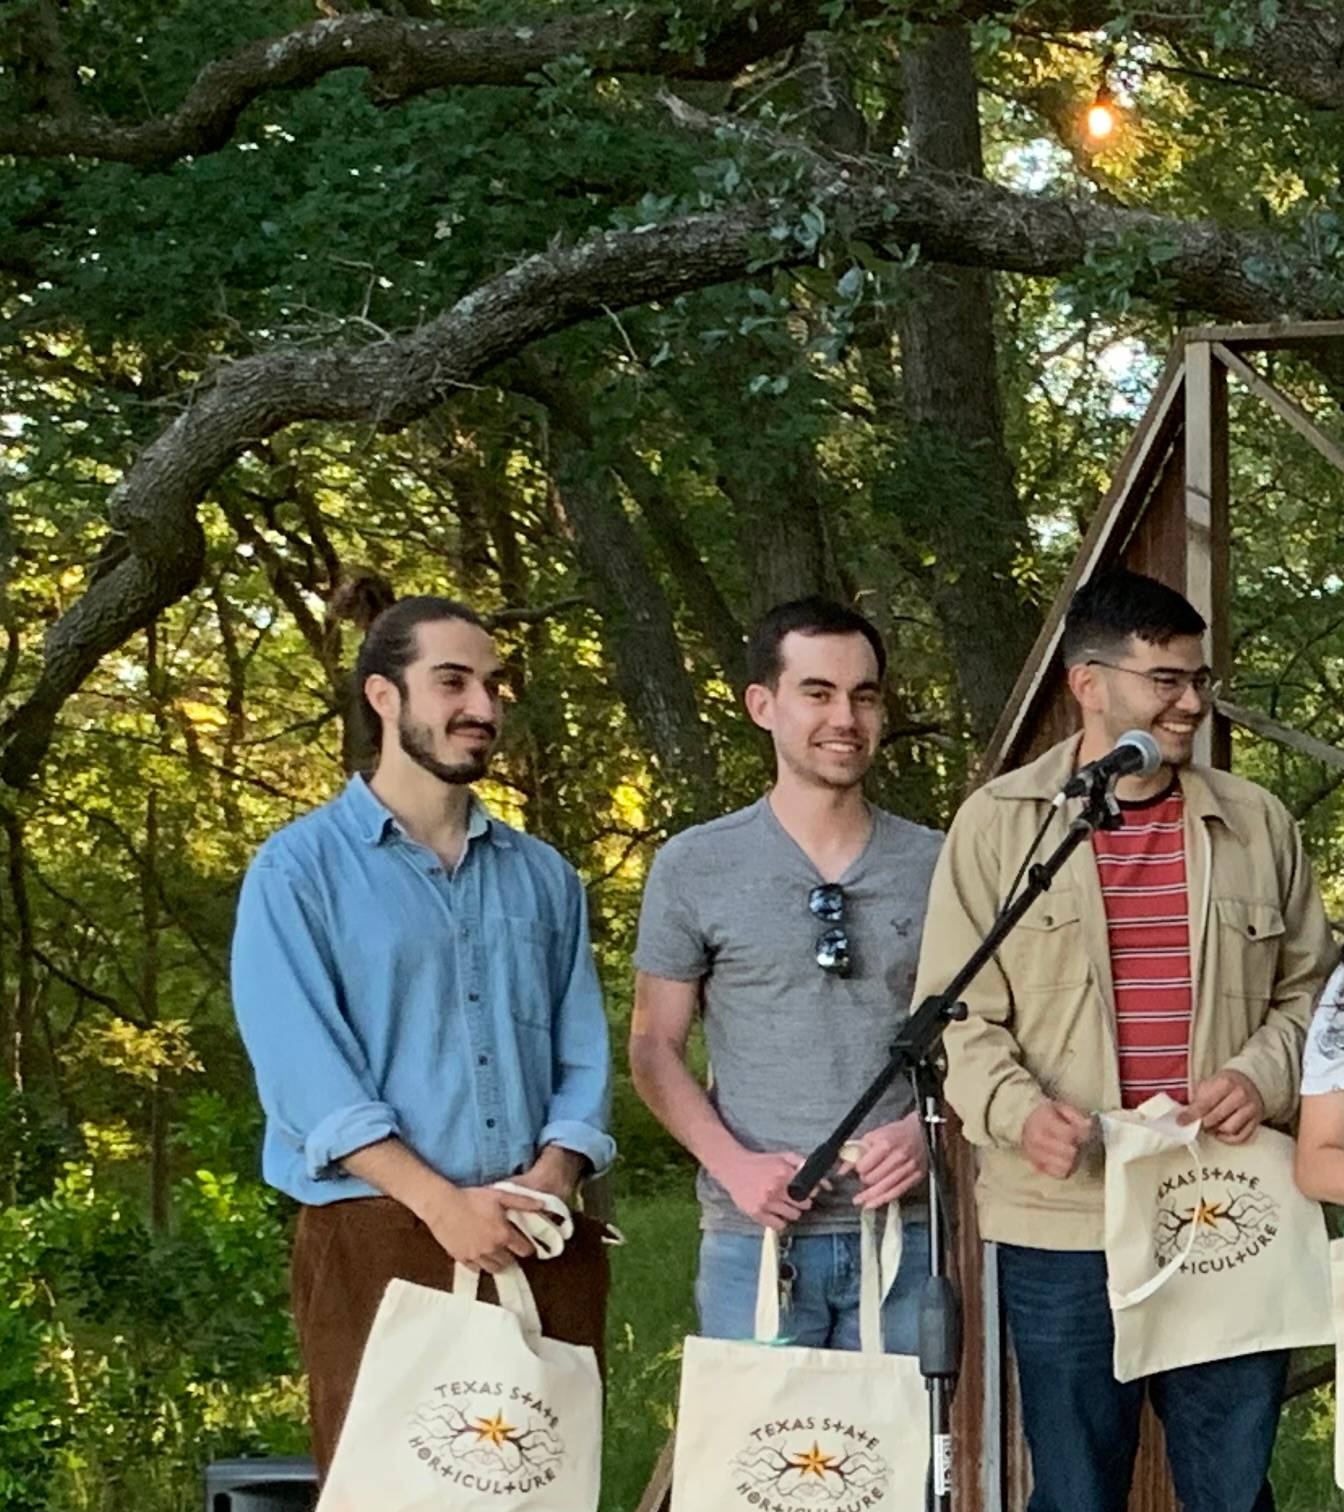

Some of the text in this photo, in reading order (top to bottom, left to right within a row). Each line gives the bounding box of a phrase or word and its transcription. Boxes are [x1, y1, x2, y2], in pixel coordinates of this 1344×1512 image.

[1158, 1167, 1260, 1199] XAS STATE
[1154, 1223, 1278, 1275] OTICULTURE
[434, 1379, 560, 1430] TEXAS STATE
[749, 1416, 880, 1451] TEXAS STATE
[407, 1435, 557, 1496] HORTICULTURE
